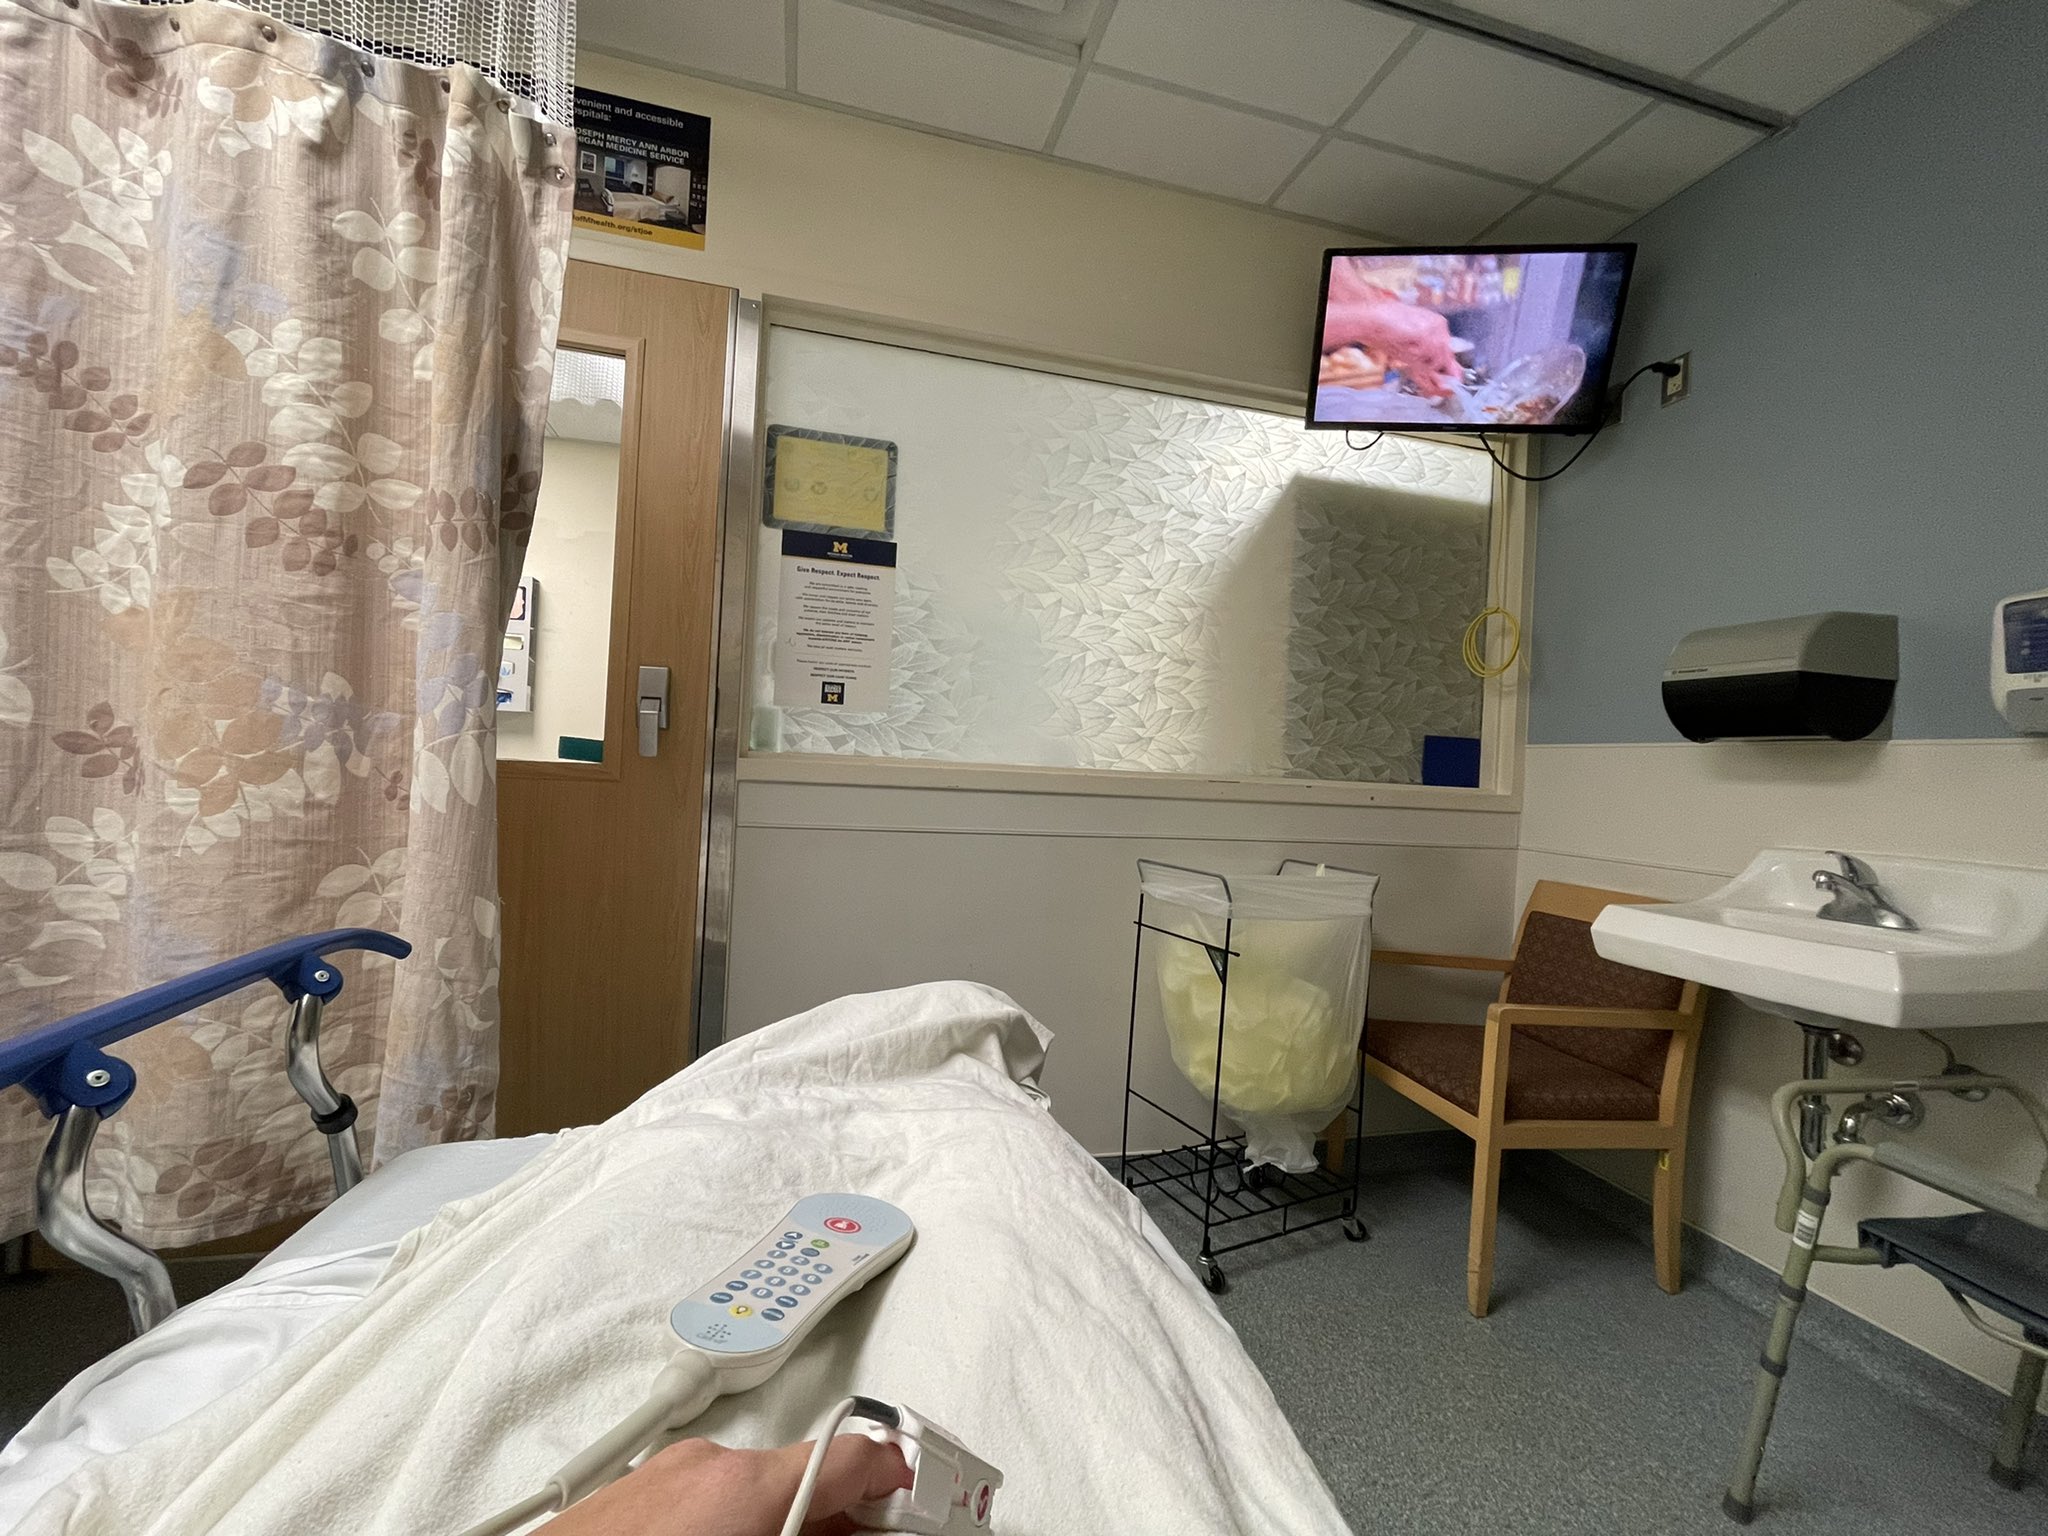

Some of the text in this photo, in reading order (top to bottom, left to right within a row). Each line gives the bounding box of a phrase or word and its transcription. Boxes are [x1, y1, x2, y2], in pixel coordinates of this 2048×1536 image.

[574, 98, 684, 128] venient and accessible
[605, 141, 648, 157] MEDICINE
[649, 151, 685, 165] SERVICE
[606, 134, 638, 146] MERCY
[638, 141, 658, 152] ANN
[660, 146, 690, 159] ARBOR
[833, 541, 848, 553] M
[796, 565, 810, 573] Give
[811, 567, 836, 576] Respect.
[836, 570, 856, 578] Expect
[827, 693, 839, 702] M
